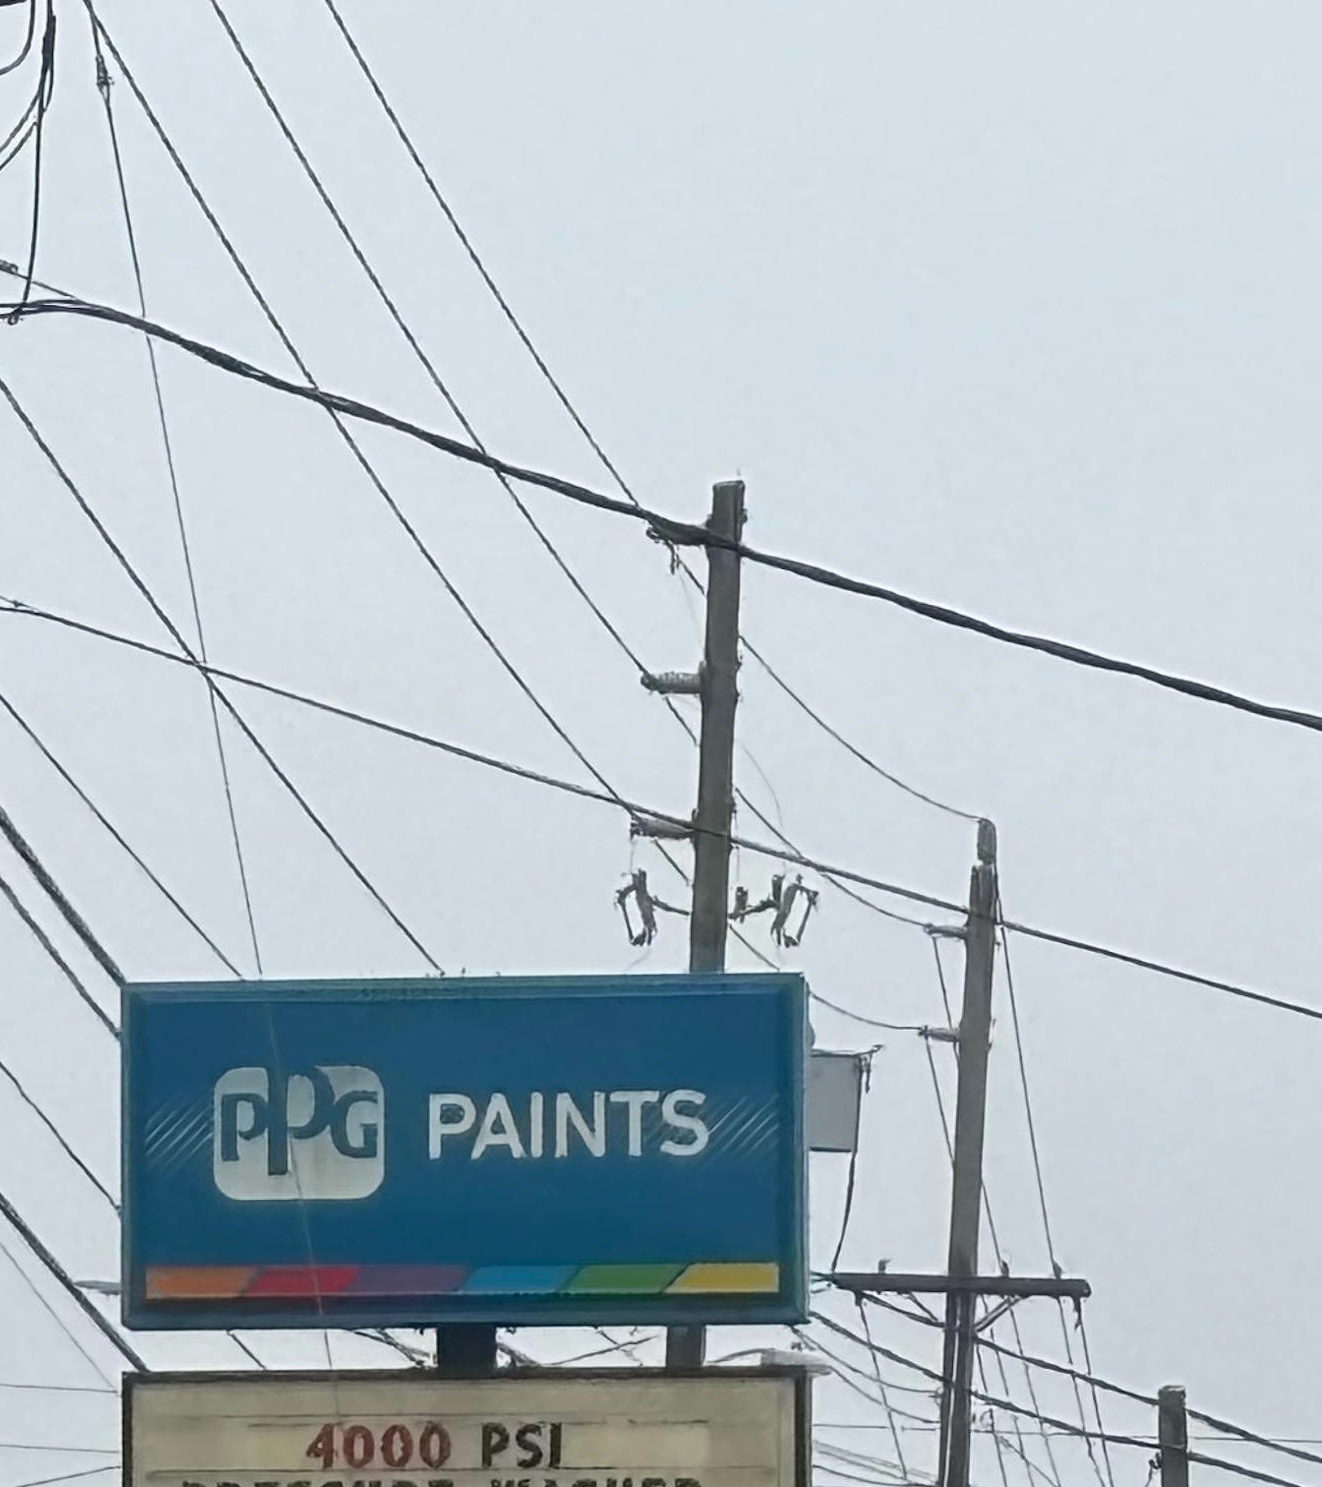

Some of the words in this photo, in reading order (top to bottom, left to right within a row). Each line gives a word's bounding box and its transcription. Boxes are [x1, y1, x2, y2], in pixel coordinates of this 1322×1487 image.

[220, 1064, 379, 1176] PPG
[428, 1089, 710, 1160] PAINTS
[305, 1422, 452, 1470] 4000
[481, 1421, 562, 1469] PSI
